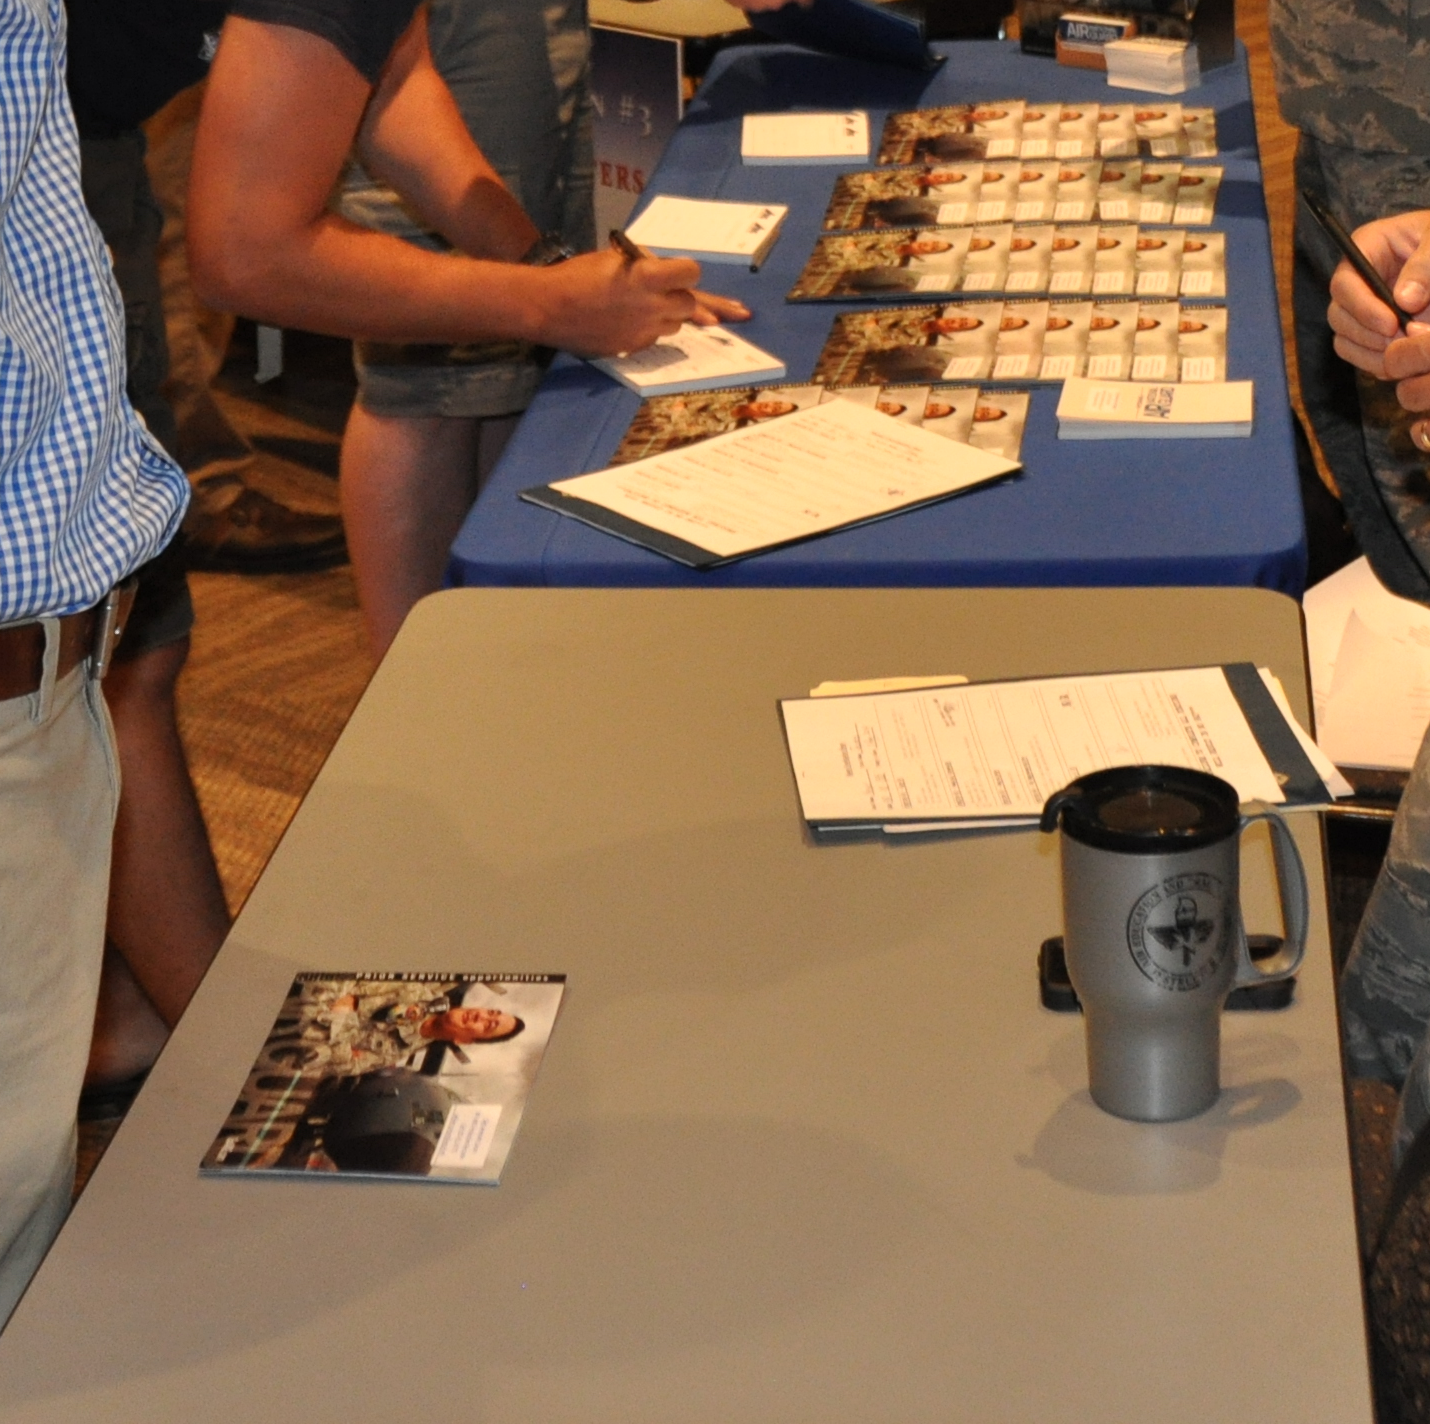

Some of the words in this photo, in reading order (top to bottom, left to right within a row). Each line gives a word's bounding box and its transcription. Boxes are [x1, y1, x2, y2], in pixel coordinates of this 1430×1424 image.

[1067, 22, 1090, 40] AIR
[620, 95, 652, 137] #3
[356, 971, 395, 981] PRIOR
[401, 972, 455, 982] SERVICE
[462, 973, 550, 983] opportunities
